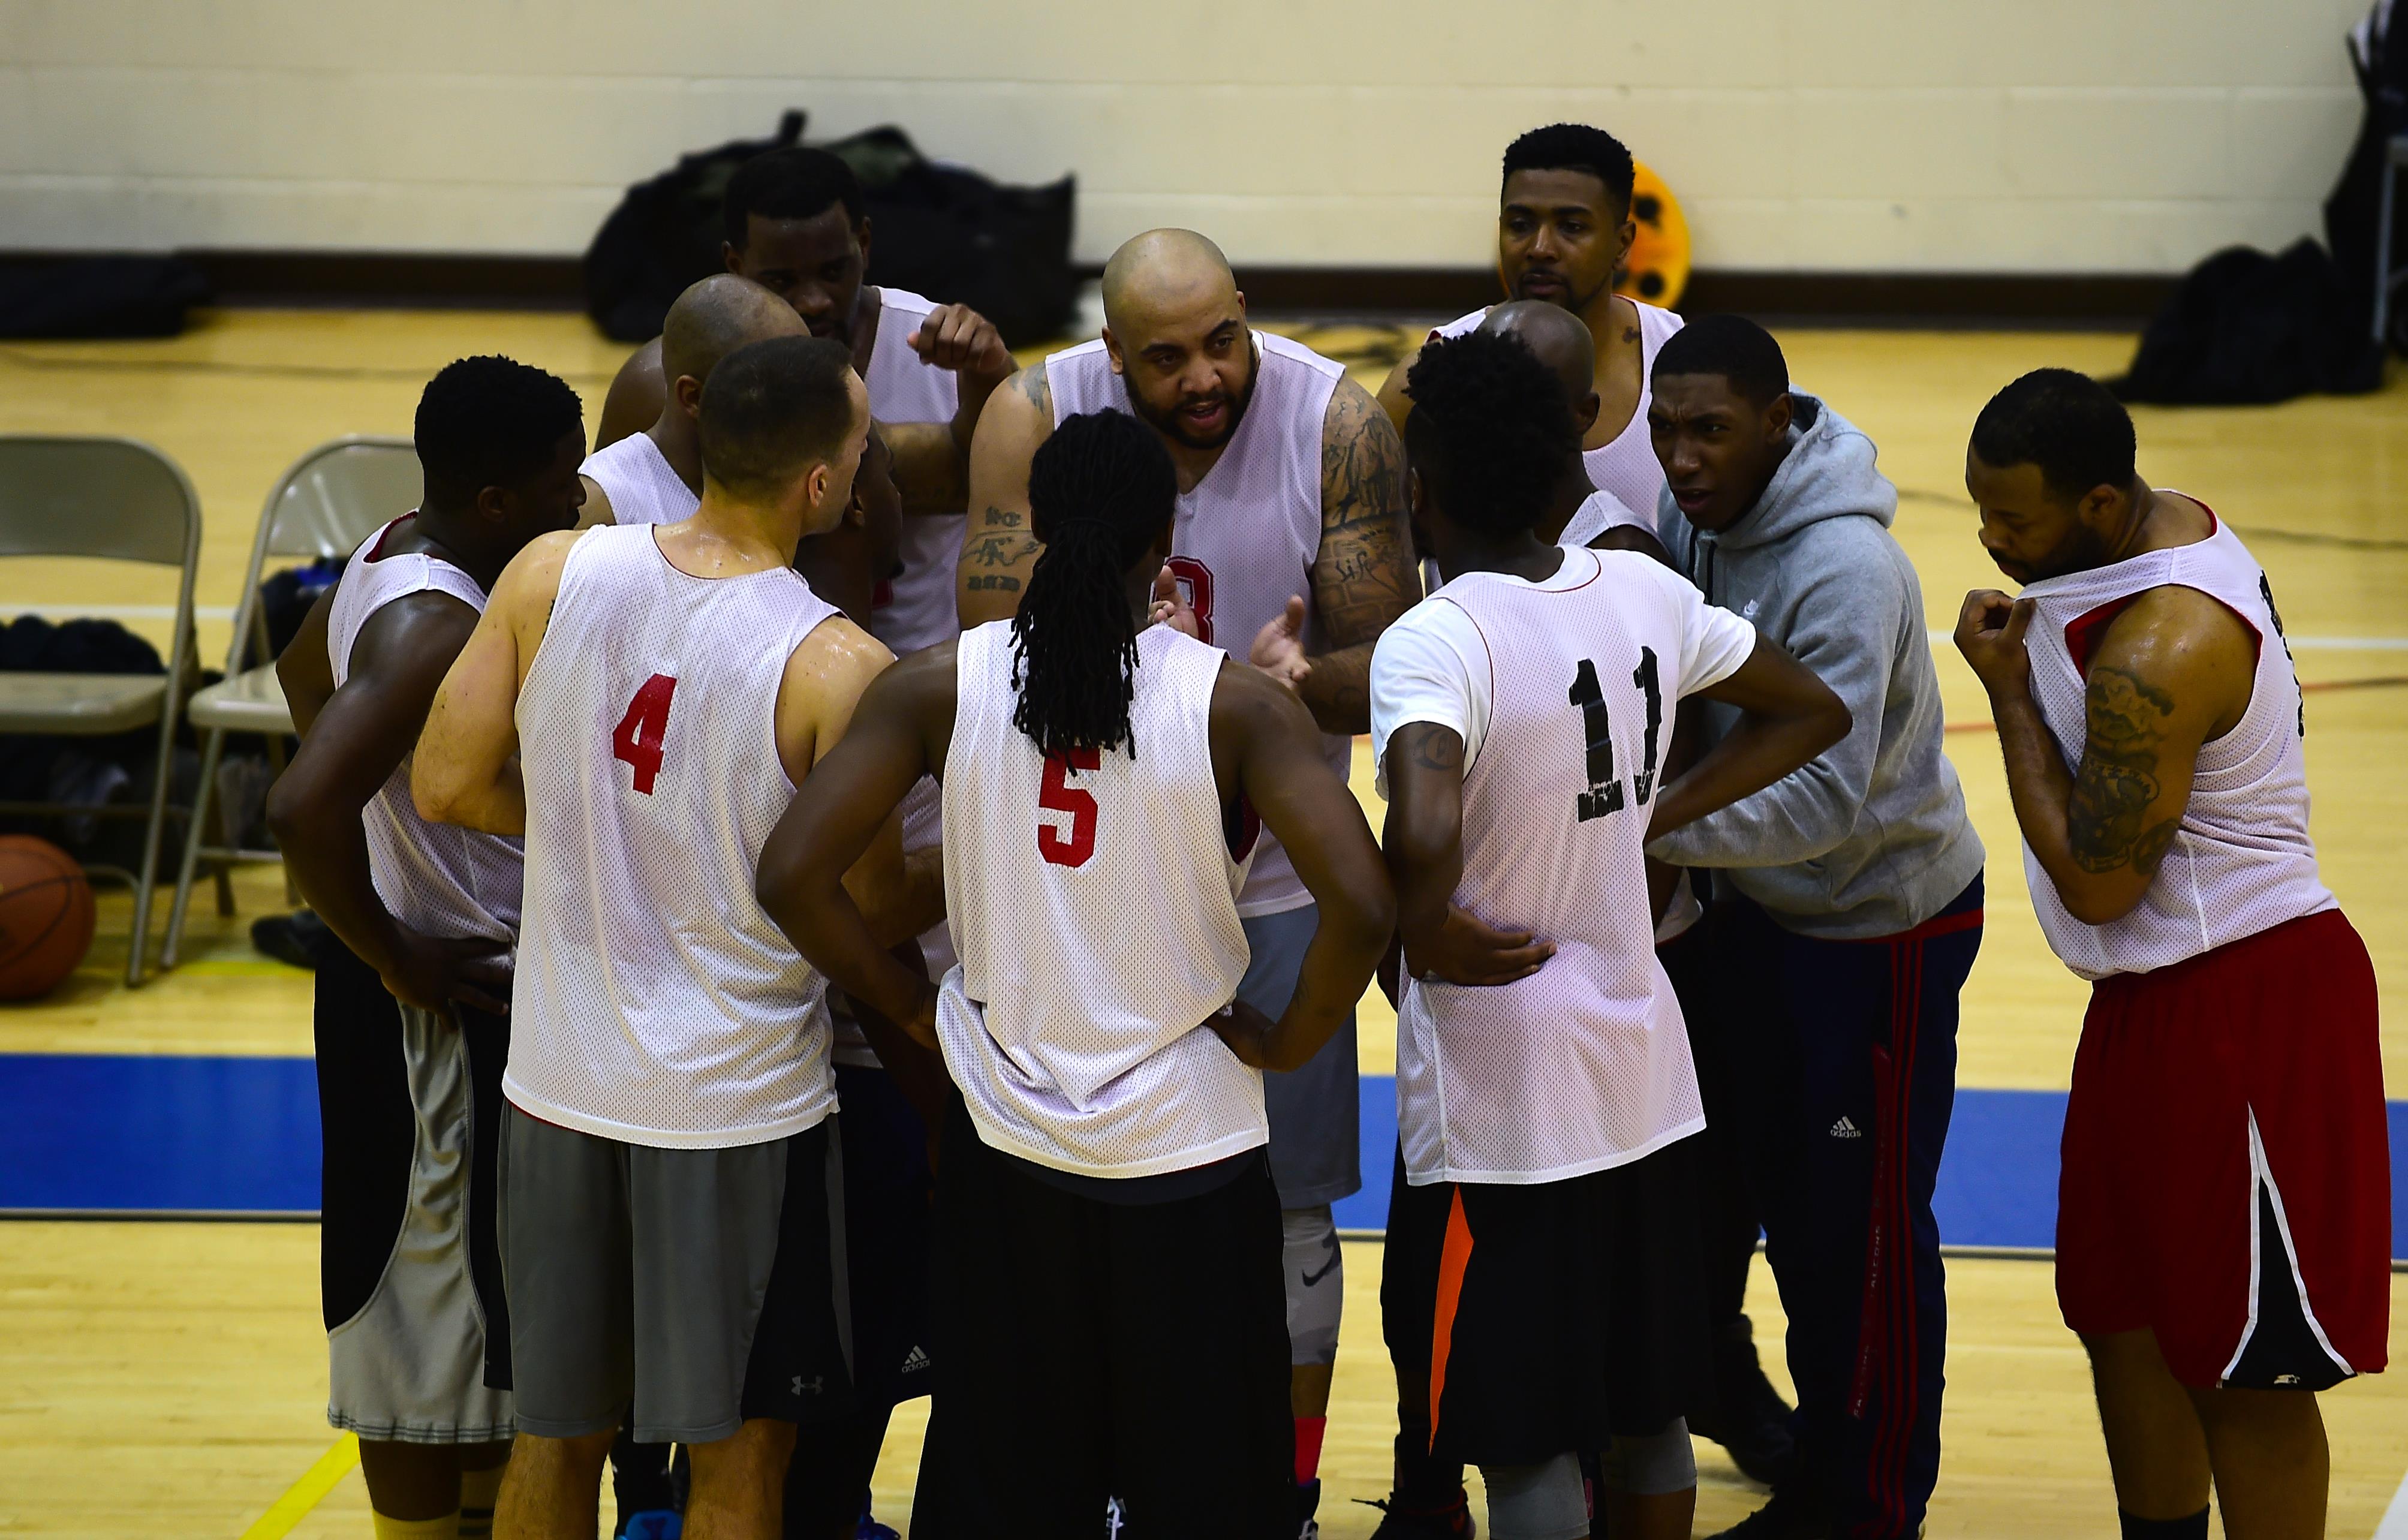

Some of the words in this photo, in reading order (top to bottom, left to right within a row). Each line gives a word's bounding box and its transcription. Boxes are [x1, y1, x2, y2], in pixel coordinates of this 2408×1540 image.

[612, 673, 677, 796] 4
[1568, 645, 1662, 822] 11
[1038, 742, 1100, 868] 5
[1830, 1129, 1861, 1138] adidas
